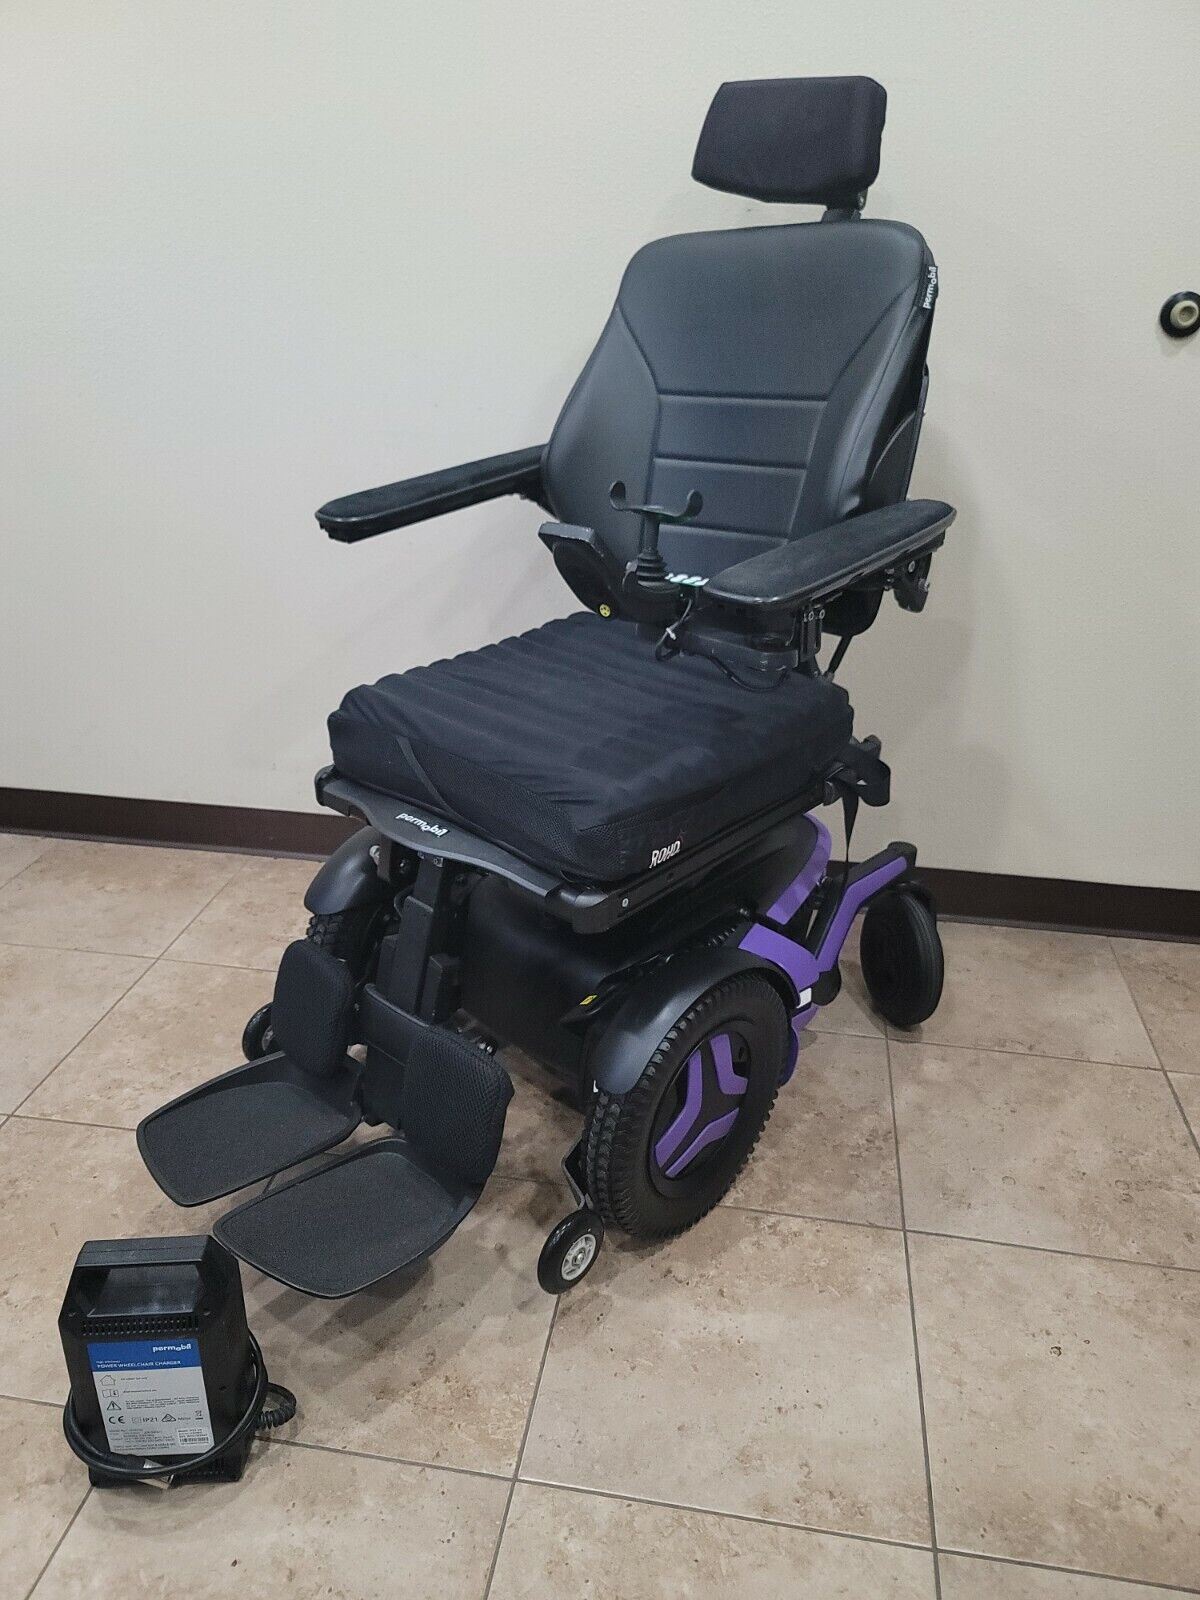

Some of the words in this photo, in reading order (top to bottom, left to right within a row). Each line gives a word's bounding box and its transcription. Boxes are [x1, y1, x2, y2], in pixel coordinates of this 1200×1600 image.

[923, 266, 937, 309] permobil
[395, 813, 449, 837] permobil
[152, 1343, 192, 1353] permobil
